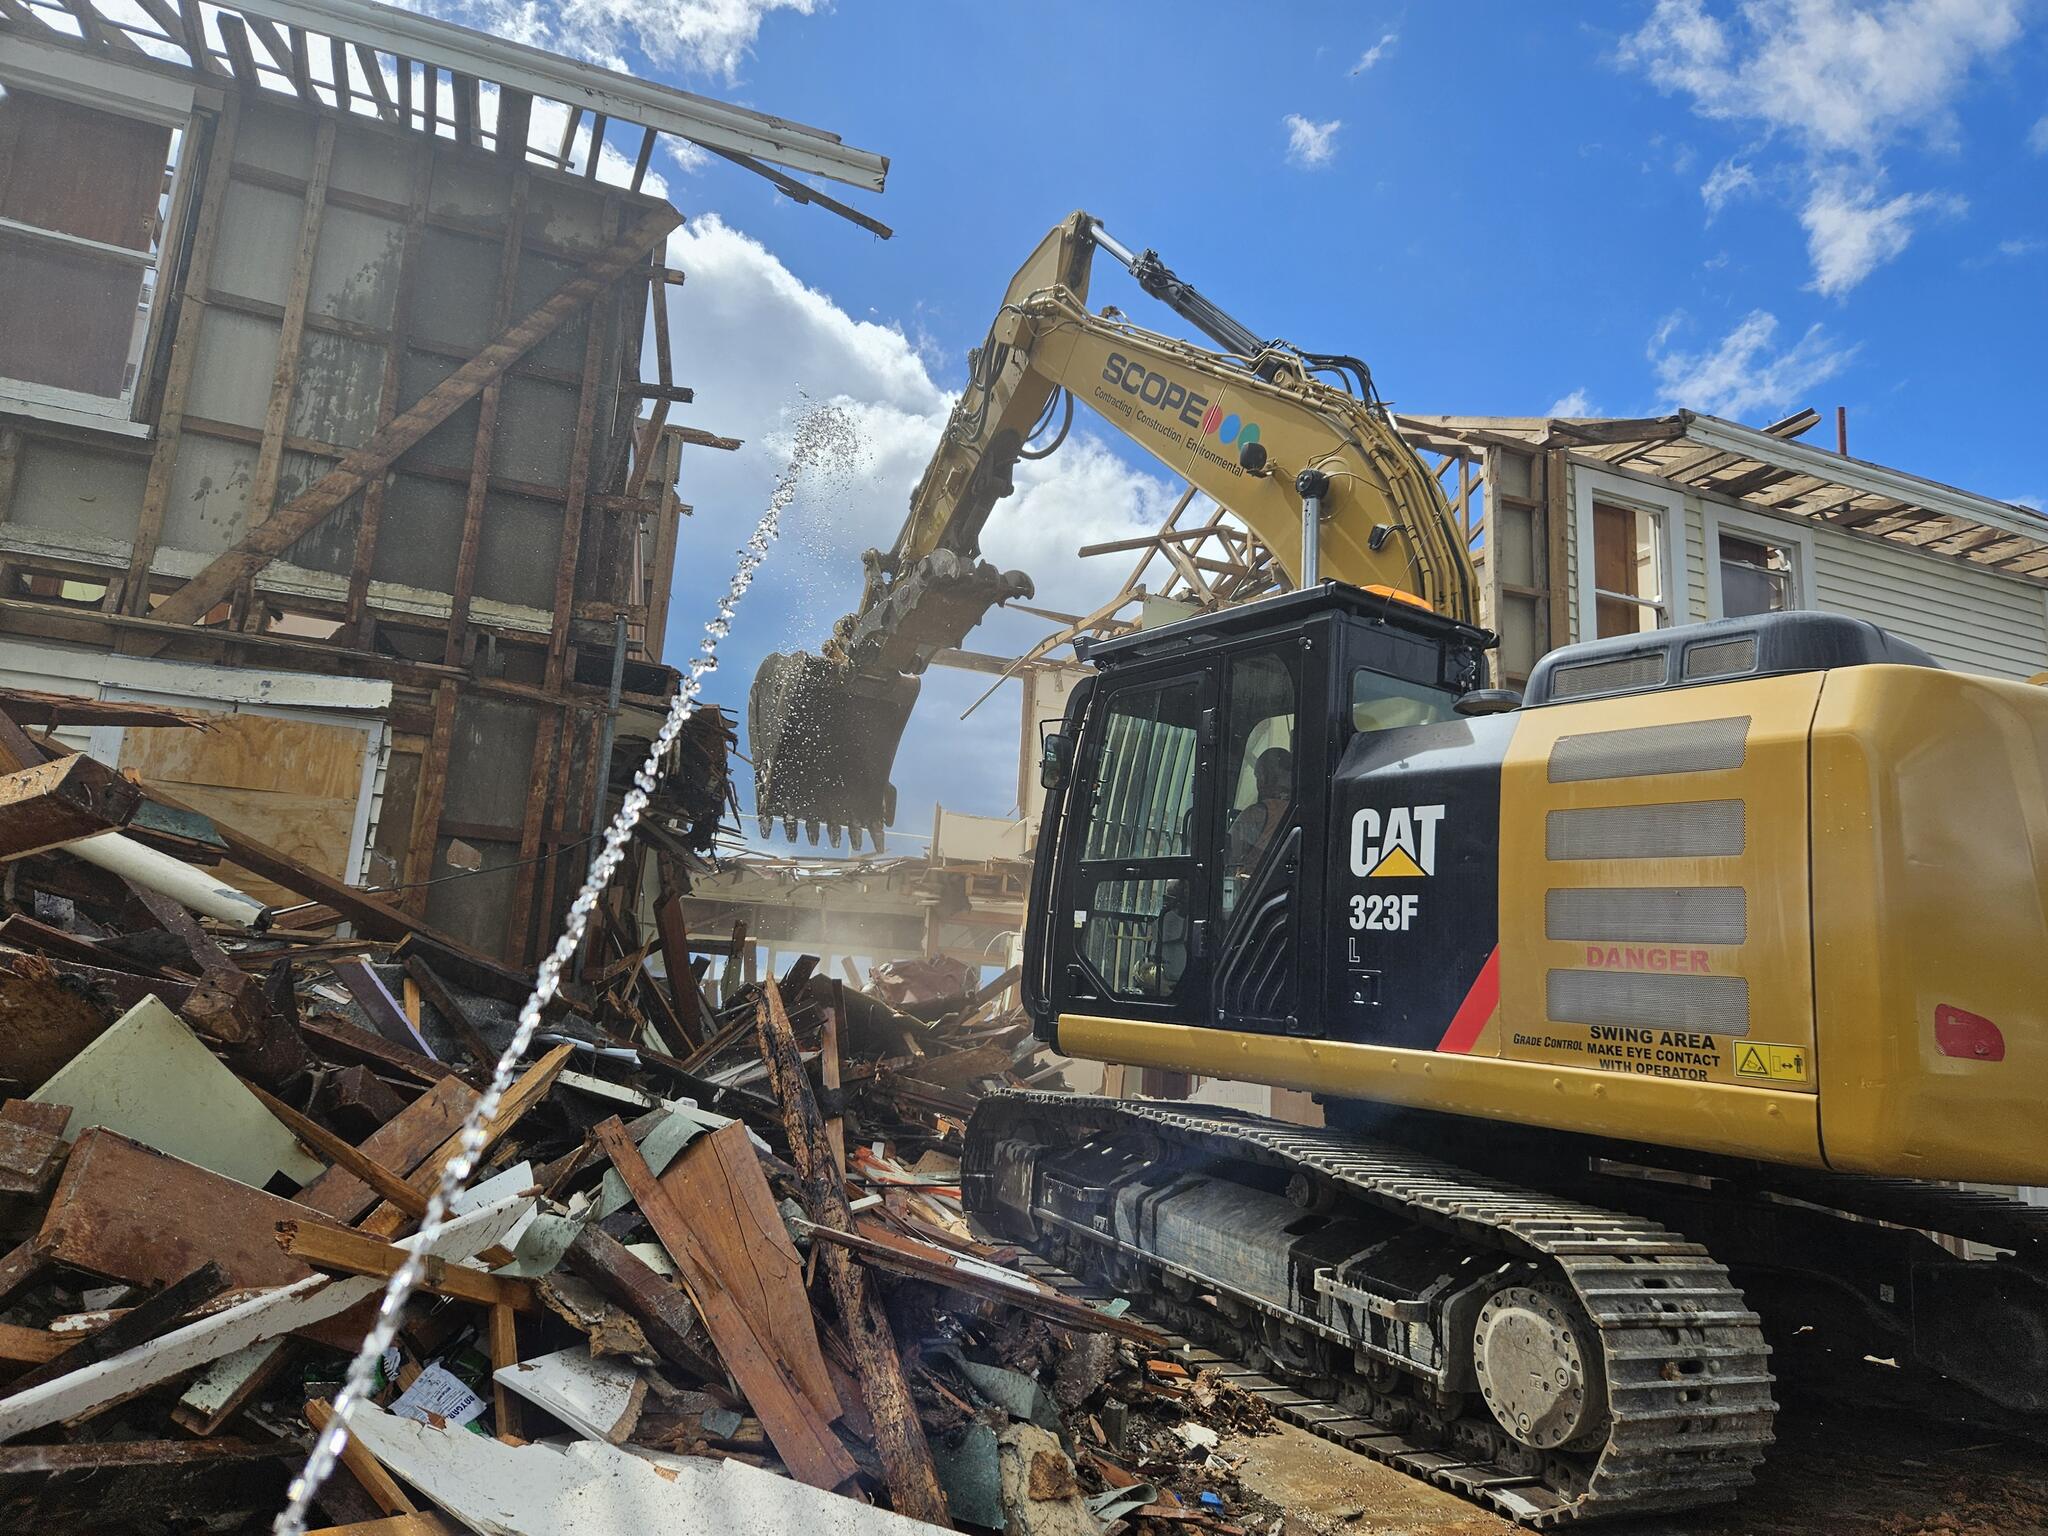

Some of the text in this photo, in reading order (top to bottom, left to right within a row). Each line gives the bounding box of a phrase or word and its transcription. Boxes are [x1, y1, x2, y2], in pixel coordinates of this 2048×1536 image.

[1102, 352, 1209, 429] SCOPE
[1094, 386, 1245, 477] Contracting Construction Enironmental
[1350, 804, 1445, 877] CAT
[1349, 894, 1419, 931] 323F
[1348, 937, 1360, 963] L
[1585, 945, 1712, 973] DANGER
[1513, 1033, 1583, 1051] GRADE CONTROL
[1590, 1025, 1716, 1050] SWING AREA
[1587, 1043, 1720, 1067] MAKE EYE CONTACT
[1599, 1058, 1708, 1082] WITH OPERATOR
